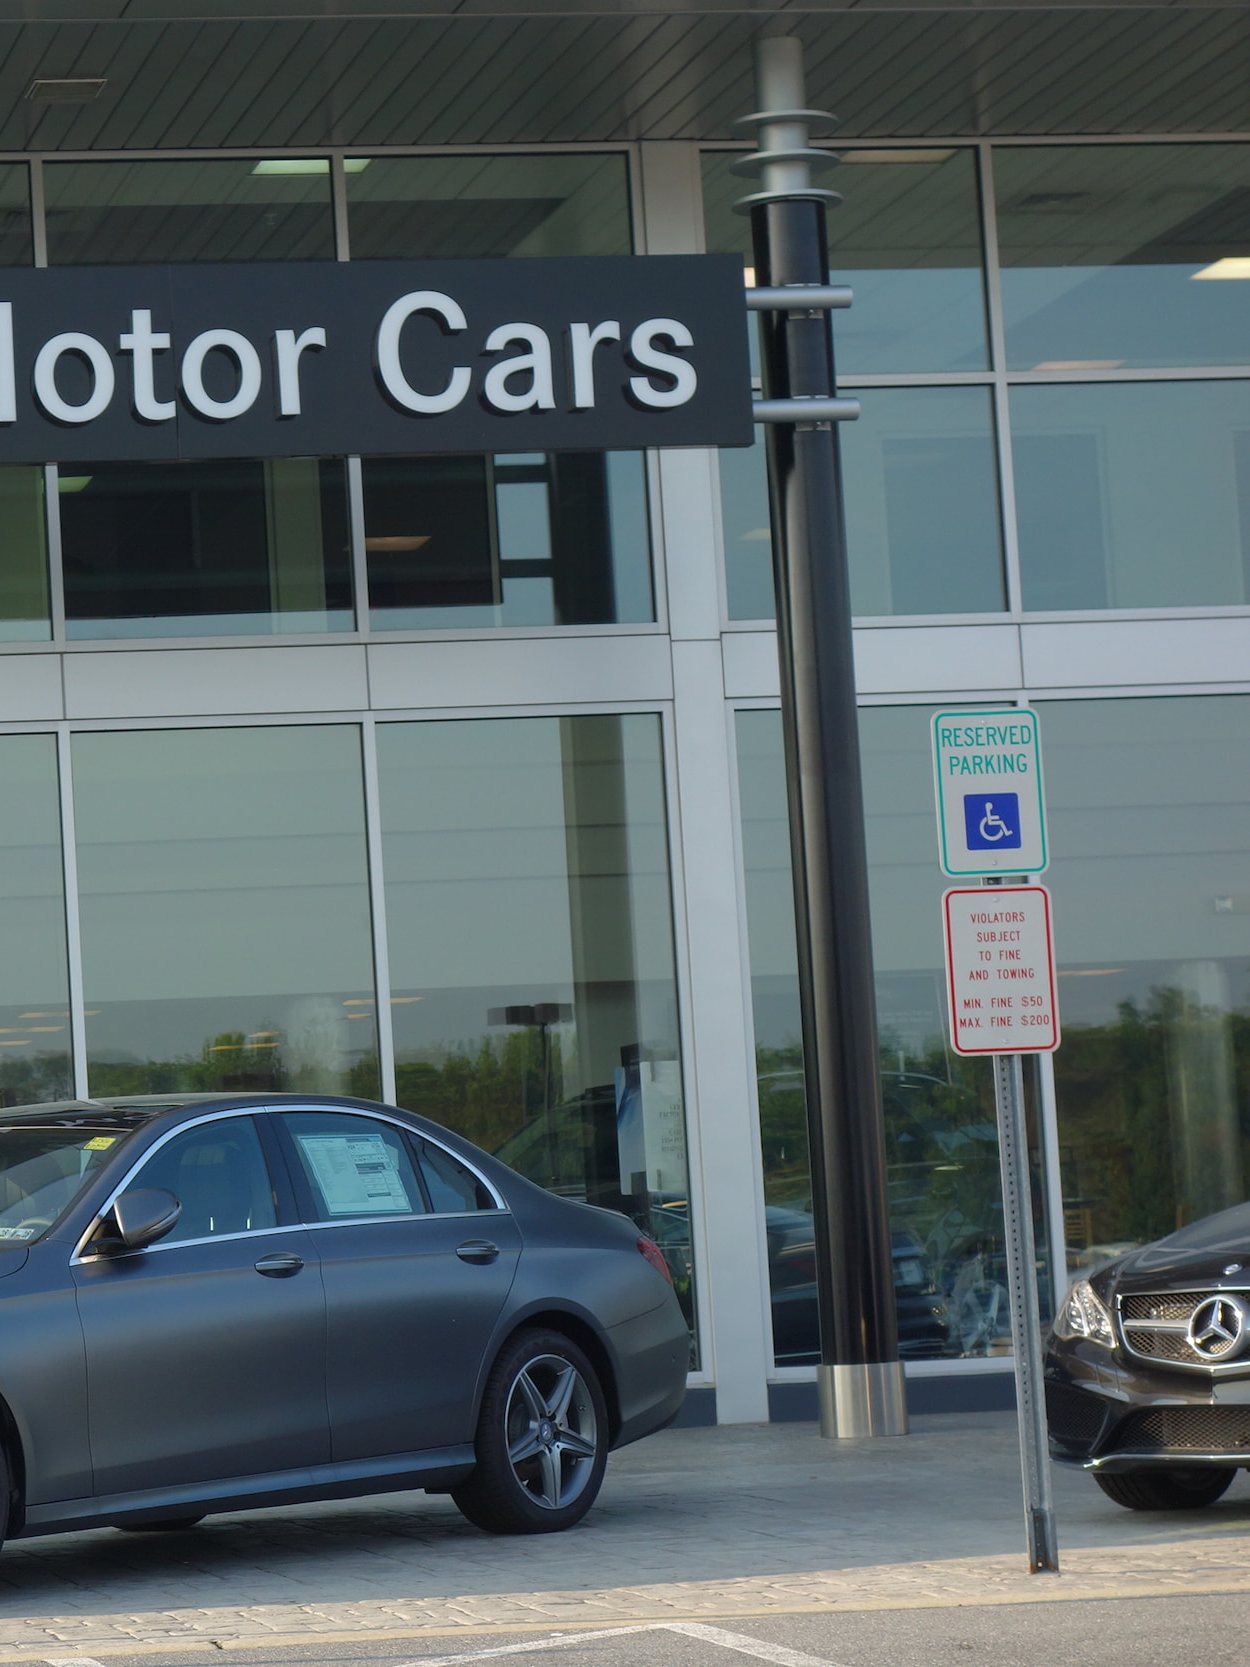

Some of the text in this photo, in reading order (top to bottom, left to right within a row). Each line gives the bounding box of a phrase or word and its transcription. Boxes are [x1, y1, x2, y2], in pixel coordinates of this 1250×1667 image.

[376, 290, 698, 414] Cars
[941, 724, 1033, 748] RESERVED
[948, 752, 1029, 776] PARKING
[970, 912, 1025, 924] VIOLATORS
[976, 930, 1022, 942] SUBJECT
[979, 950, 1022, 961] TO FINE
[969, 968, 1035, 980] AND TOWING
[964, 996, 1043, 1009] MIN. FINE $50
[959, 1015, 1050, 1029] MAX. FINE $200
